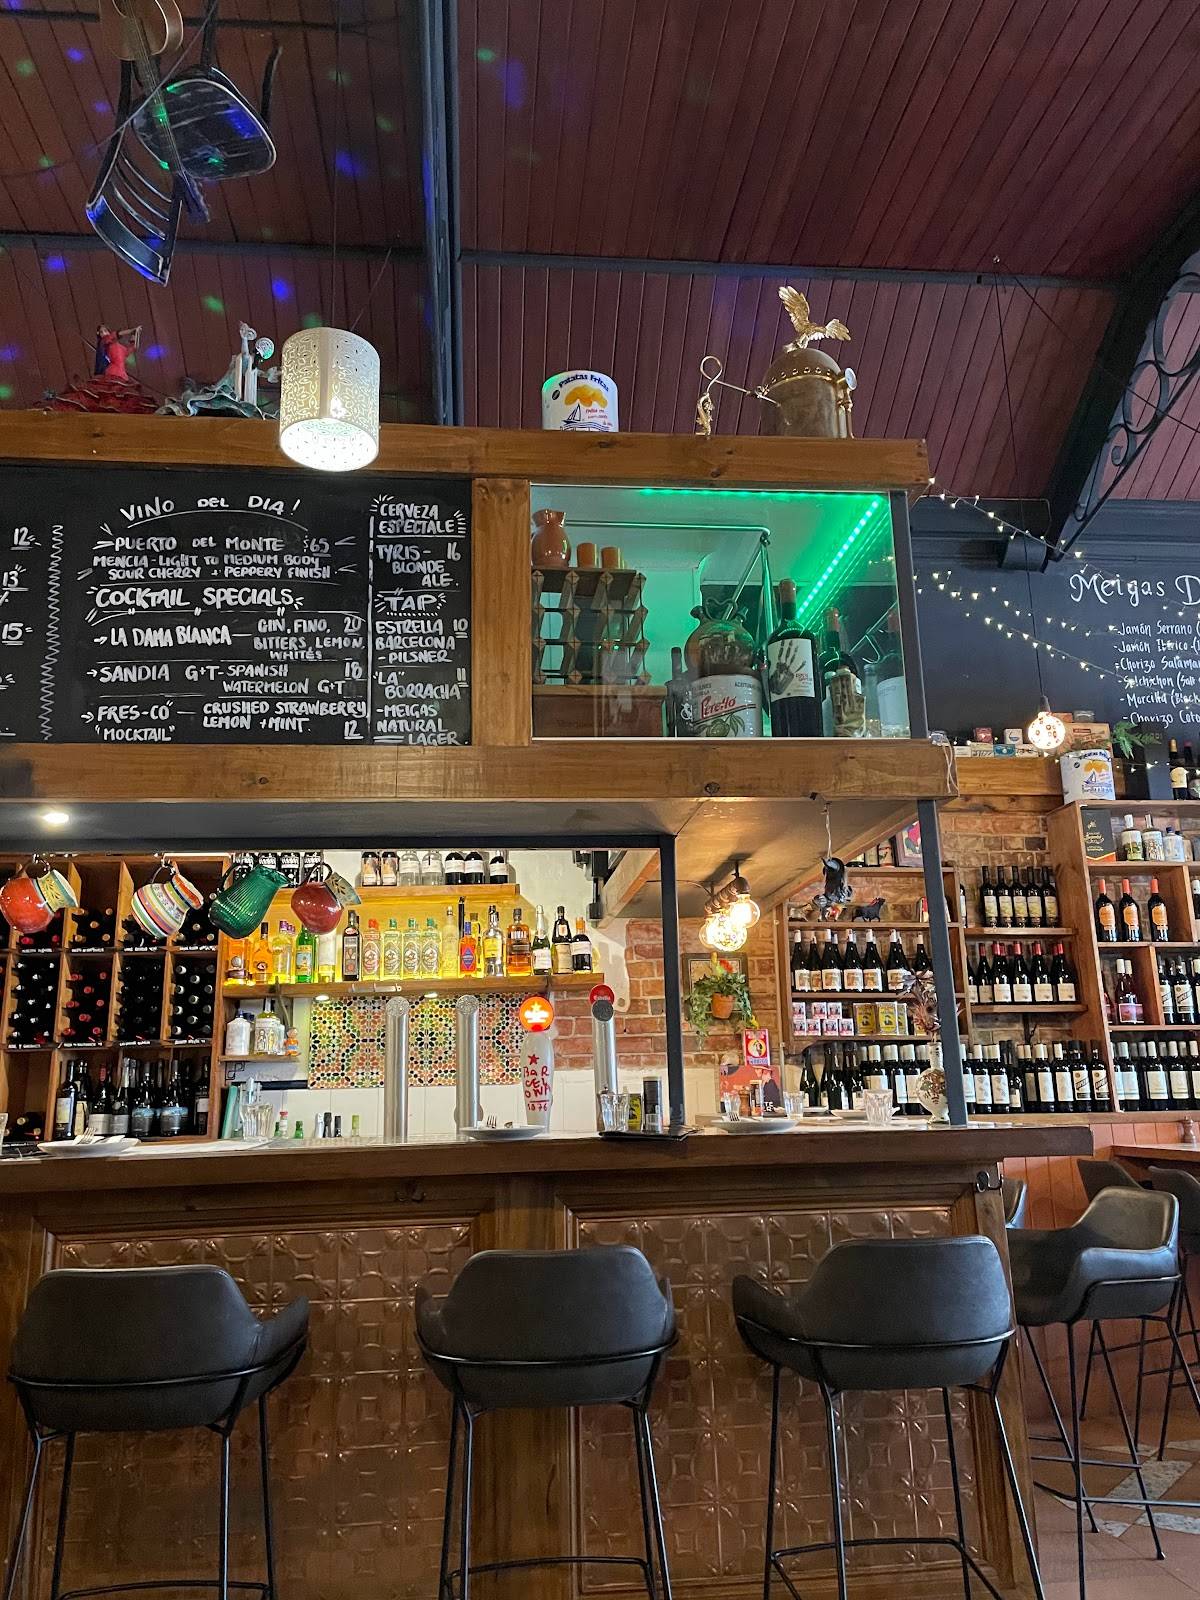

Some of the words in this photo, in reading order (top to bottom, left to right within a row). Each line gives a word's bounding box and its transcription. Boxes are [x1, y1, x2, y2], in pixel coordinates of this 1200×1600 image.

[120, 496, 175, 521] VINO
[197, 497, 229, 508] DEL
[380, 503, 439, 520] CERVEZA
[13, 526, 31, 546] 12
[114, 536, 178, 552] PUERTO
[192, 536, 217, 548] DEL
[225, 536, 286, 552] MONTE
[446, 542, 461, 561] 16
[203, 556, 220, 566] TO
[223, 554, 279, 566] MEDIUM
[283, 554, 321, 568] BODY
[392, 560, 446, 575] BLONDE
[2, 570, 20, 587] 13
[108, 568, 145, 580] SOUR
[148, 567, 201, 579] CHERRY
[224, 566, 283, 579] PEPPERY
[95, 587, 191, 609] COCKTAIL
[202, 587, 294, 609] SPECIALS
[1069, 574, 1165, 606] Meigas
[384, 595, 438, 612] TAP
[2, 622, 24, 641] 15
[293, 618, 331, 633] FINO,
[343, 616, 361, 633] 20
[375, 619, 444, 635] ESTRELLA
[453, 618, 469, 632] 10
[1157, 620, 1192, 635] Serrano
[110, 627, 128, 647] LA
[132, 627, 173, 648] DAMA
[175, 624, 232, 646] BLANCA
[375, 635, 455, 651] BARCELONA
[100, 663, 170, 683] SANDIA
[222, 678, 309, 695] WATERMELON
[384, 683, 461, 700] BORRACHA
[203, 701, 270, 717] CRUSHED
[203, 716, 252, 730] LEMON
[344, 719, 361, 737] 12
[376, 718, 449, 733] NATURAL
